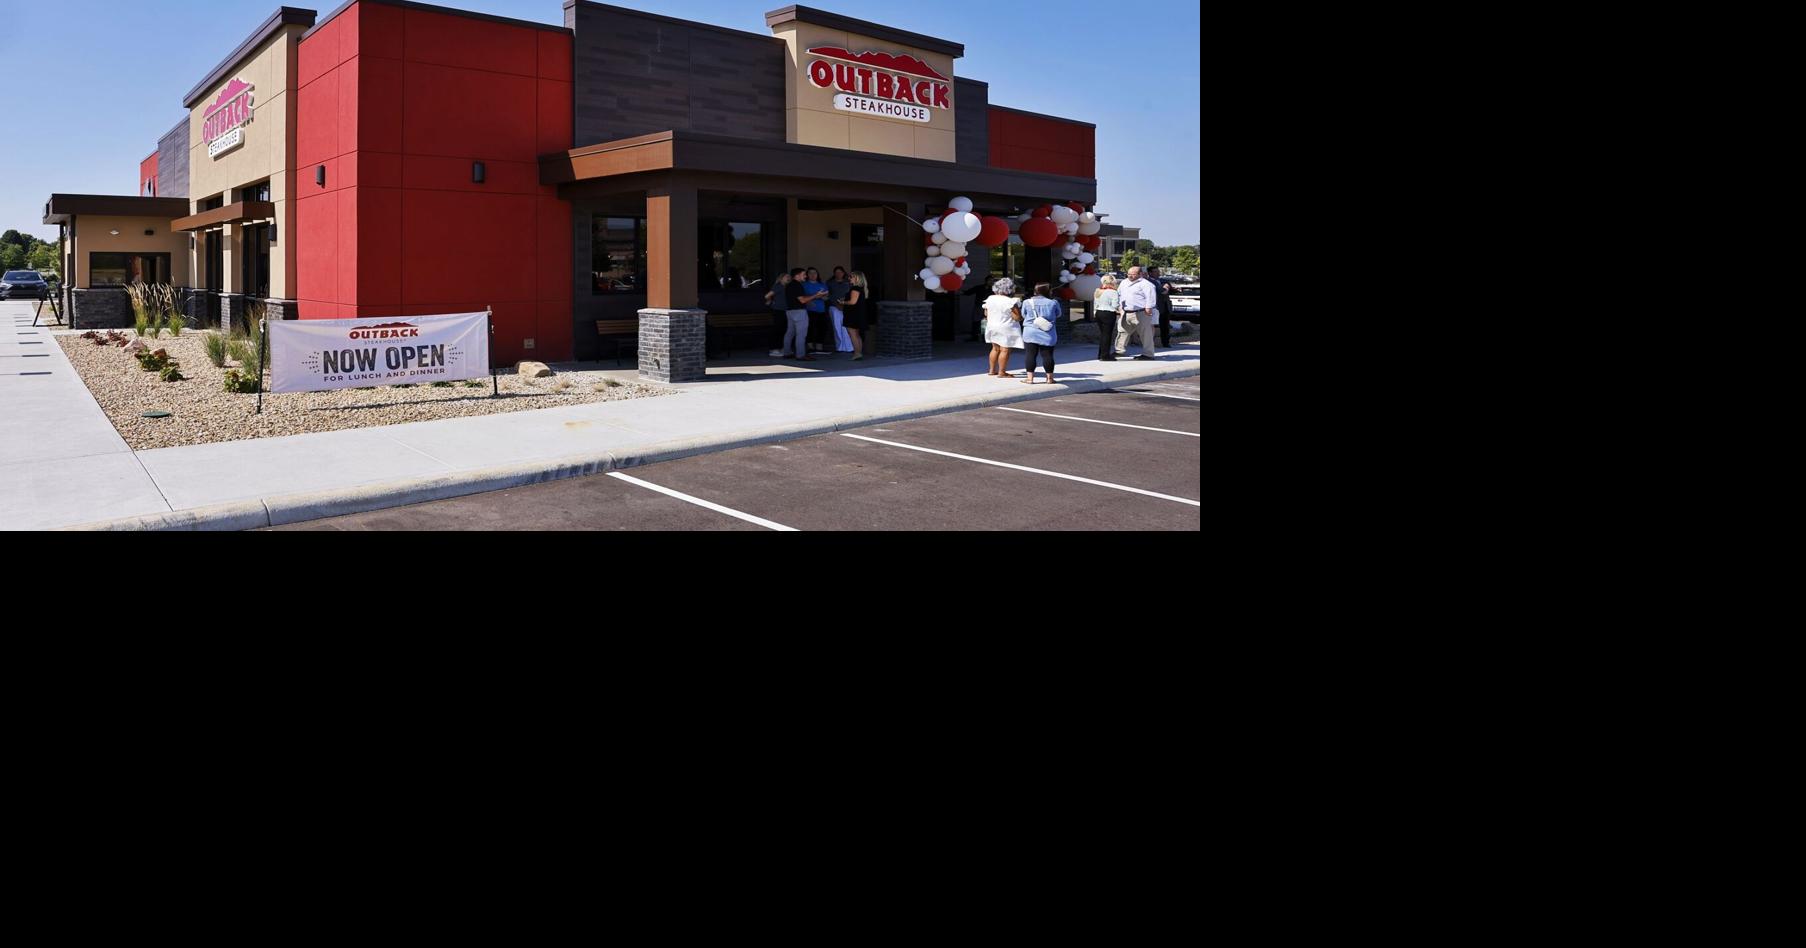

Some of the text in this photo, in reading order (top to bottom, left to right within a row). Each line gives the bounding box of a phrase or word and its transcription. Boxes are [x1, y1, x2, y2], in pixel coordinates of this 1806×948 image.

[808, 60, 950, 109] OUTBACK
[203, 91, 251, 144] OUTBACK
[845, 97, 925, 120] STEAKHOUSE
[349, 328, 419, 340] OUTBACK
[323, 344, 445, 374] NOW OPEN
[348, 373, 382, 381] LUNCH
[410, 368, 445, 376] DINNER
